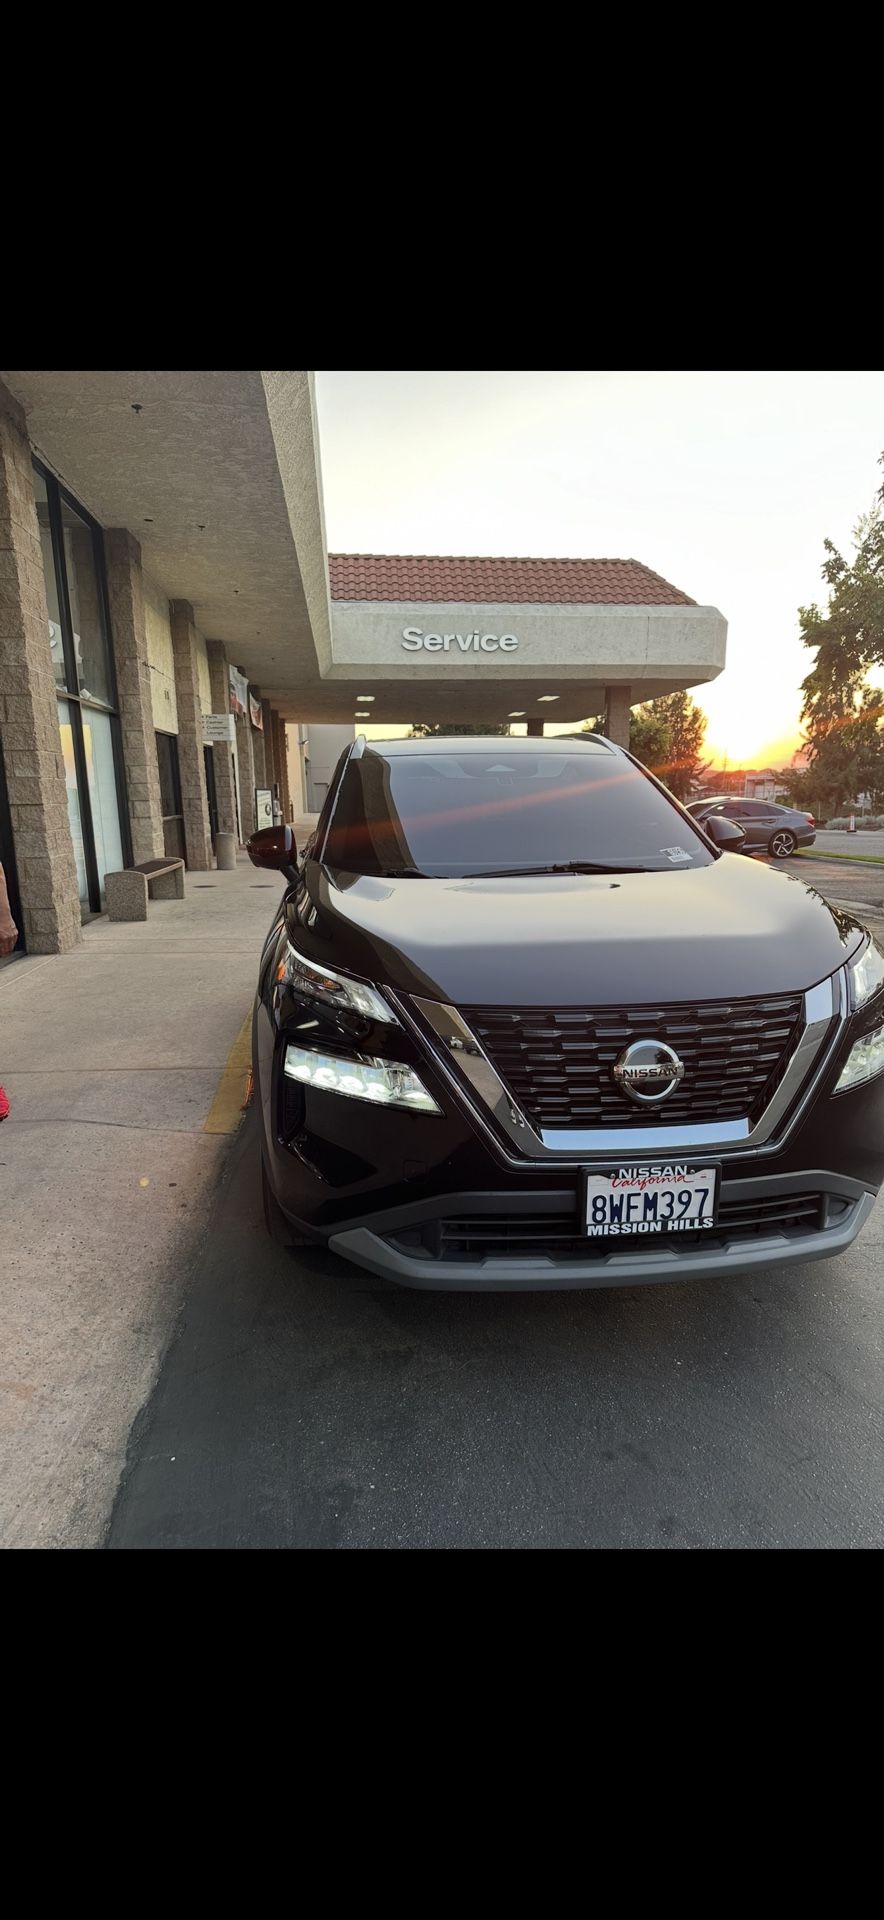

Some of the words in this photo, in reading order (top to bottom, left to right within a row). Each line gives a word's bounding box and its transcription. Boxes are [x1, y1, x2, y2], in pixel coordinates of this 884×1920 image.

[400, 626, 520, 652] Service
[622, 1067, 679, 1078] NISSAN
[618, 1165, 688, 1179] NISSAN
[611, 1175, 694, 1191] California
[592, 1188, 710, 1224] 8WFM397
[587, 1220, 662, 1236] MISSION
[667, 1217, 714, 1231] HILLS
